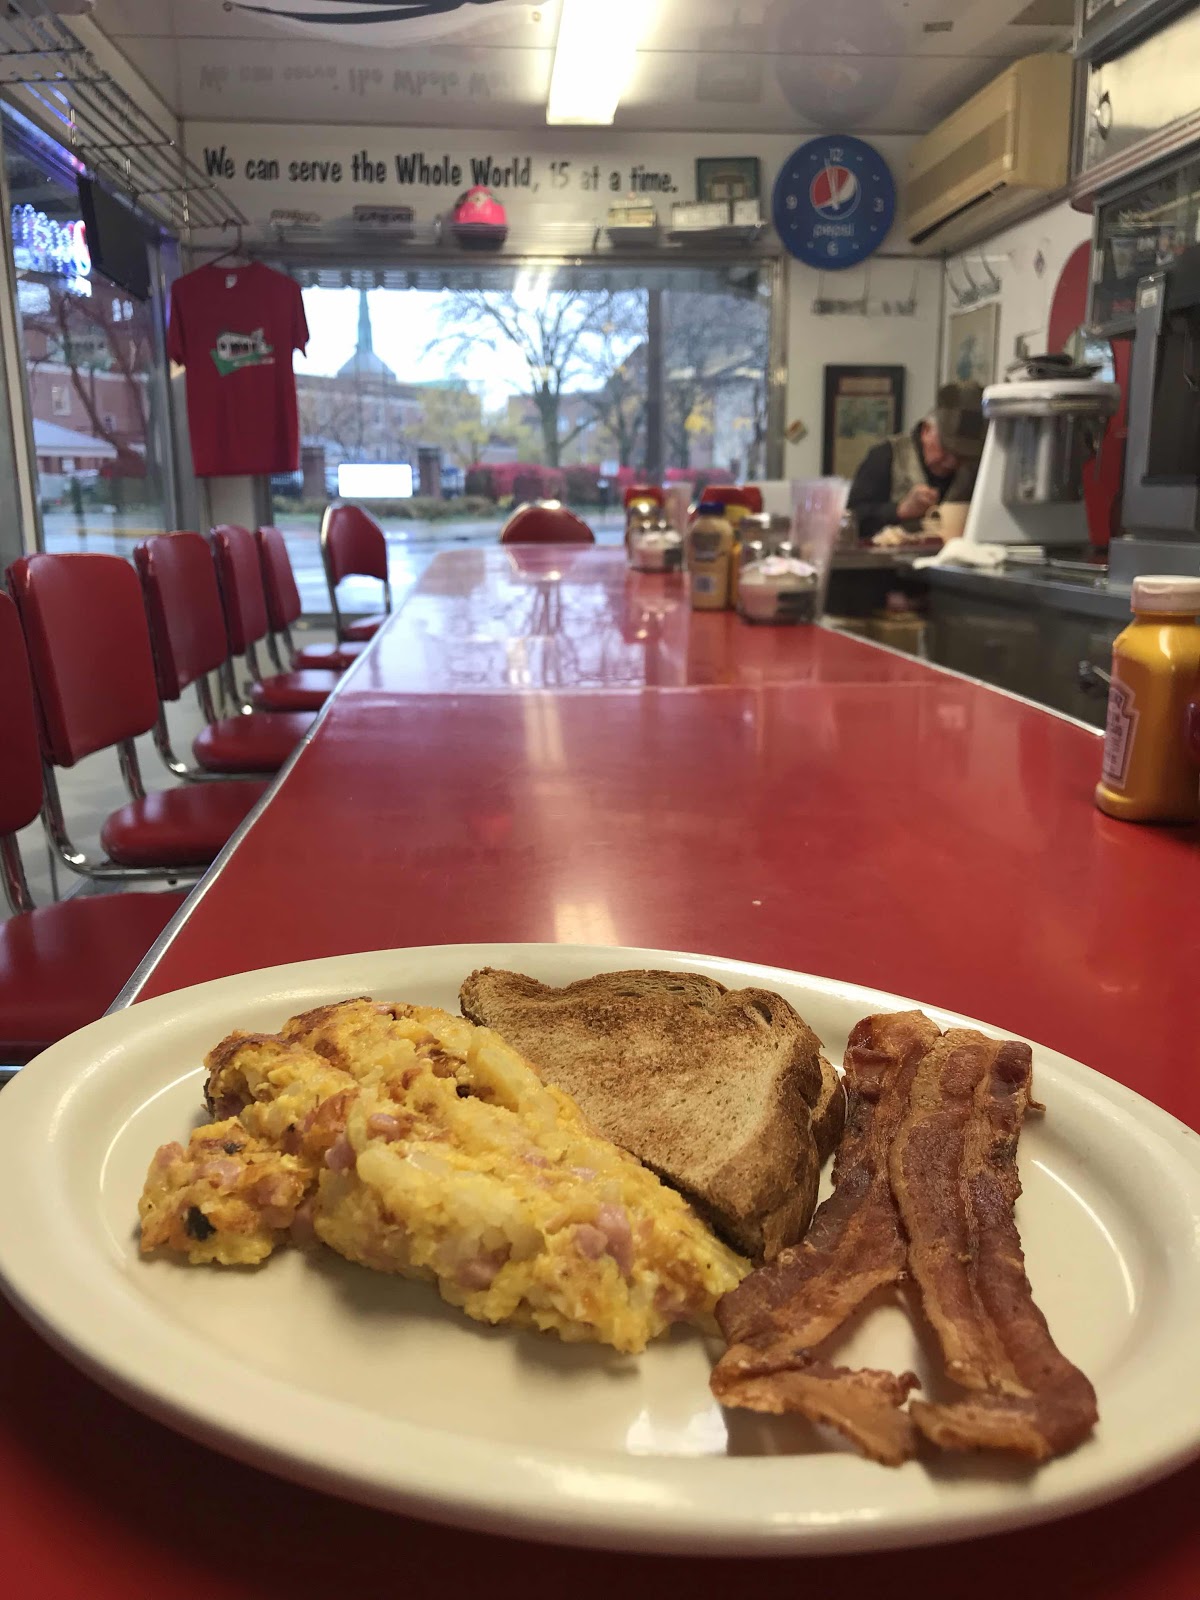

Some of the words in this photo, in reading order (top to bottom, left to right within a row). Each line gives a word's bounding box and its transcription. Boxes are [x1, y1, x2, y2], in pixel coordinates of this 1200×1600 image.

[203, 145, 236, 179] We
[245, 158, 280, 181] can
[288, 160, 342, 183] serve
[352, 150, 387, 184] the
[395, 152, 462, 186] Whole
[470, 155, 539, 193] World,
[550, 161, 571, 190] 15
[580, 164, 600, 191] at
[609, 170, 622, 192] a
[629, 164, 679, 193] time.
